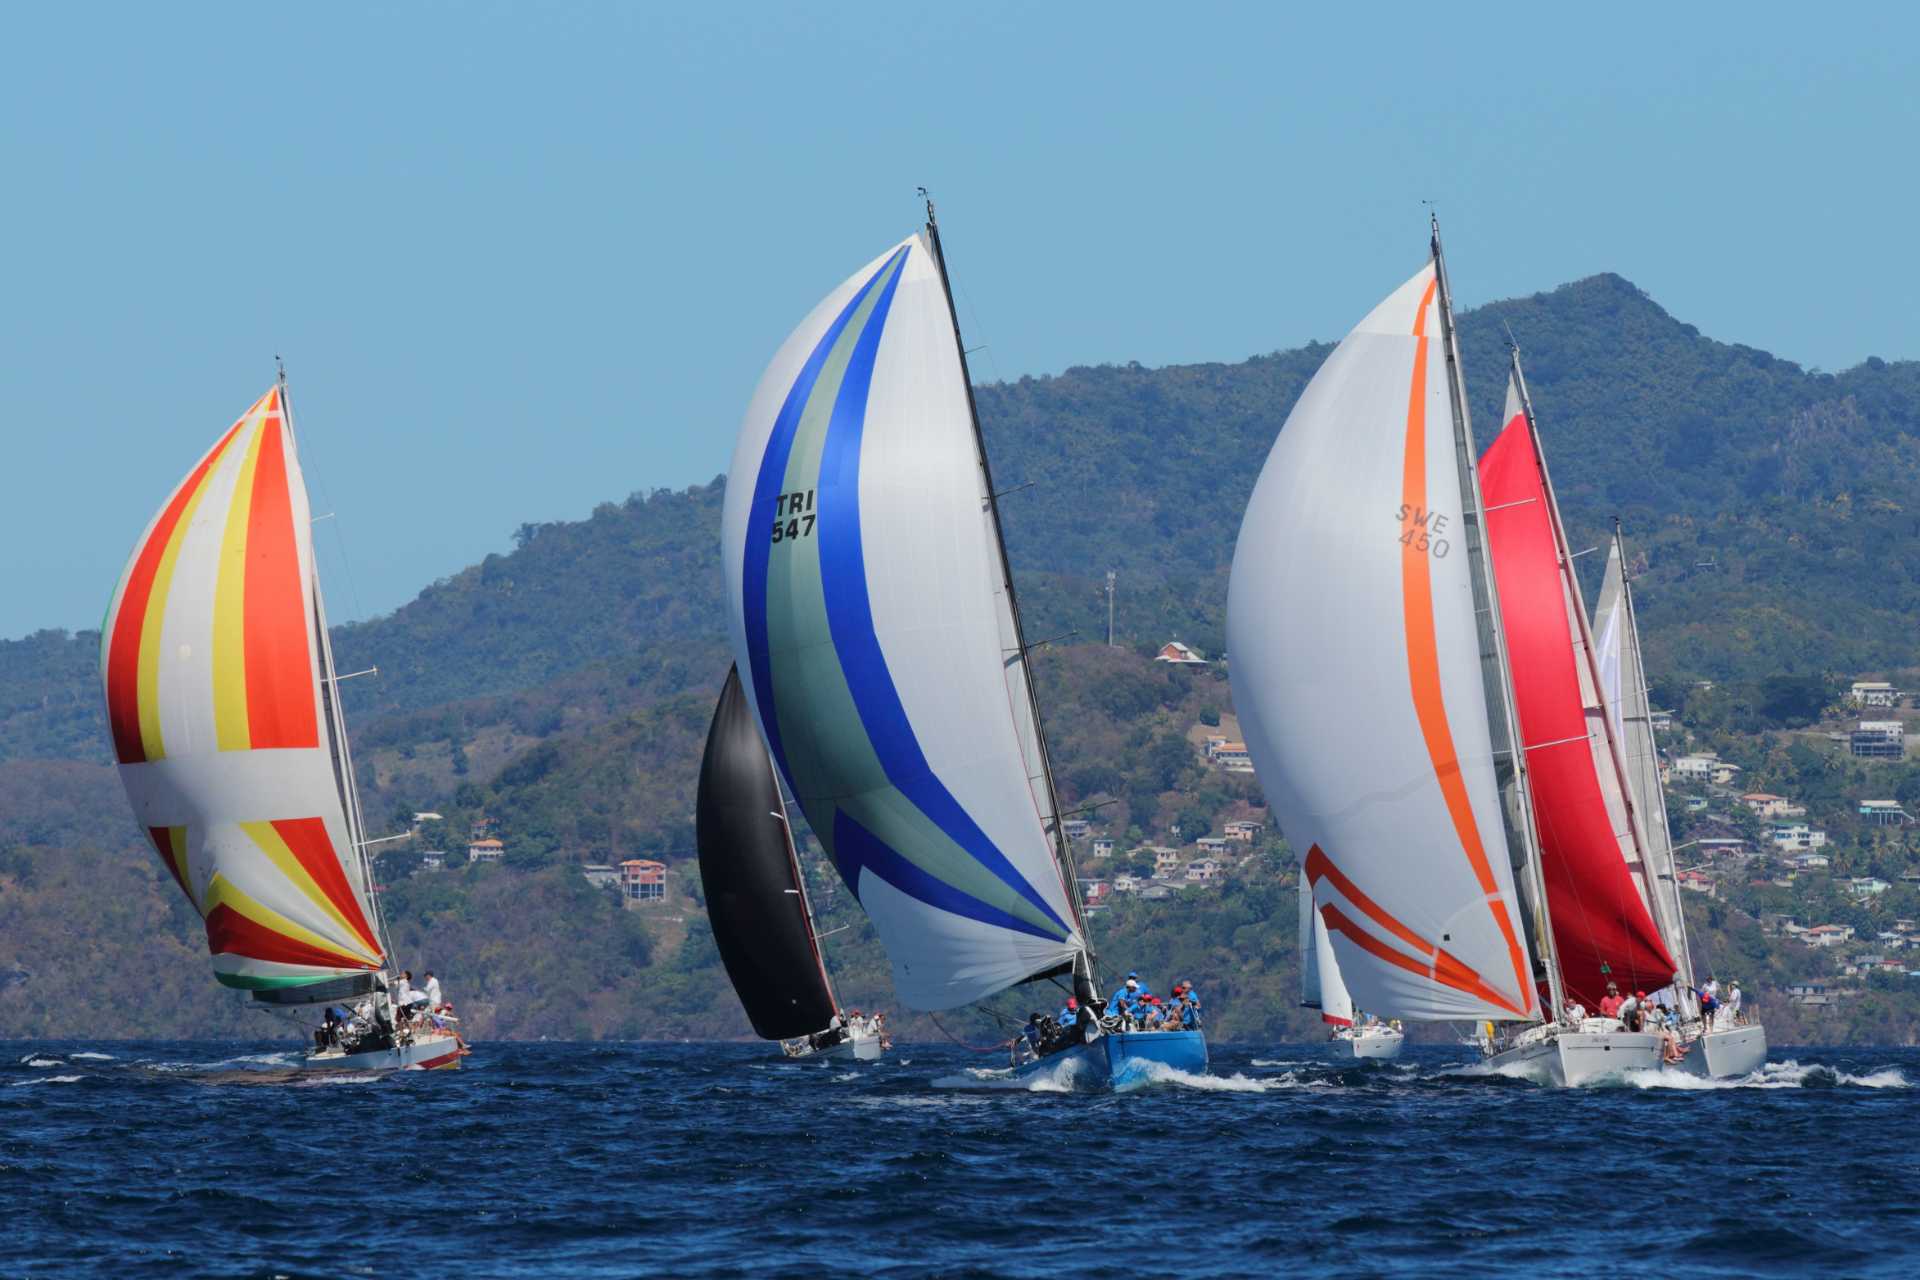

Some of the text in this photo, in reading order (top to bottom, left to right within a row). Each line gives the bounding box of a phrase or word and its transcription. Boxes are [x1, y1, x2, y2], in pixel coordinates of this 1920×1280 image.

[776, 489, 813, 516] TRI
[771, 514, 816, 543] 547
[1395, 503, 1448, 534] SWE
[1398, 529, 1450, 559] 450
